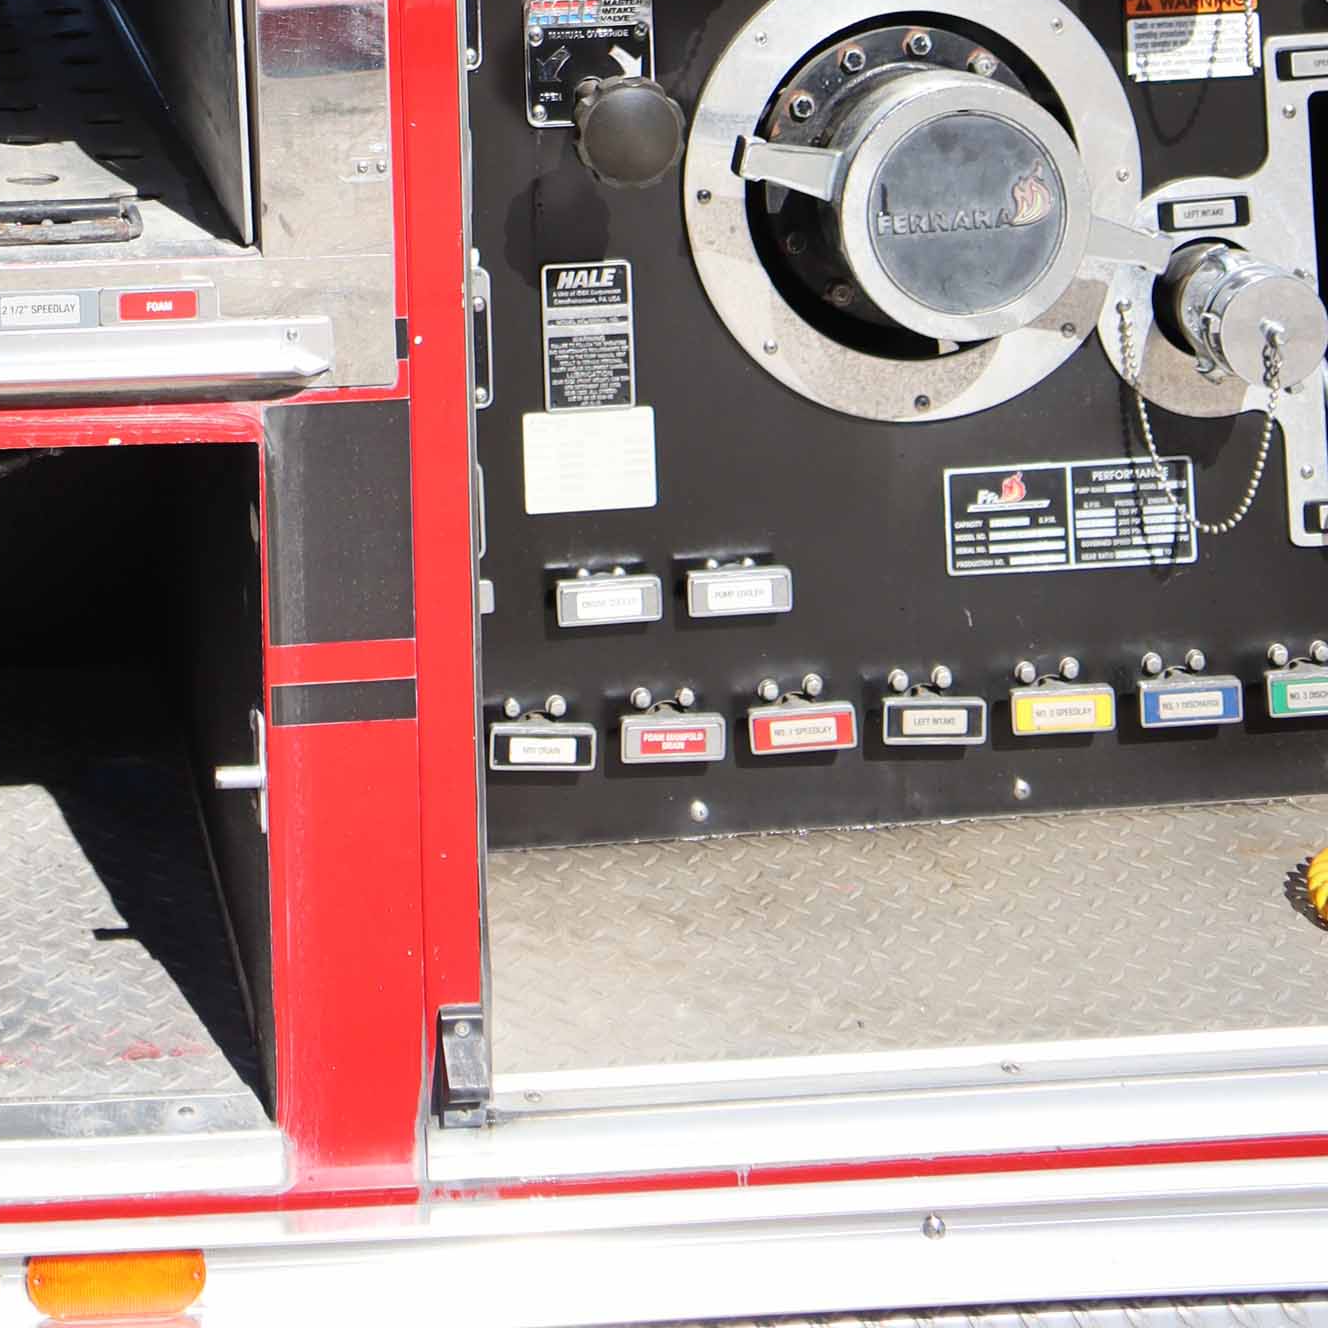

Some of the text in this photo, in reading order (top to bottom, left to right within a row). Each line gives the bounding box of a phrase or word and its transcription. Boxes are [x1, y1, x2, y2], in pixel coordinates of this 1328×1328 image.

[601, 6, 637, 14] INTAKE
[600, 14, 632, 22] VALVE
[1184, 210, 1199, 219] LEFT
[556, 267, 617, 290] HALE
[31, 303, 77, 315] SPEEDLAY
[146, 300, 173, 312] FOAM
[913, 717, 929, 726] LEFT
[795, 726, 832, 736] SPEEDLAY
